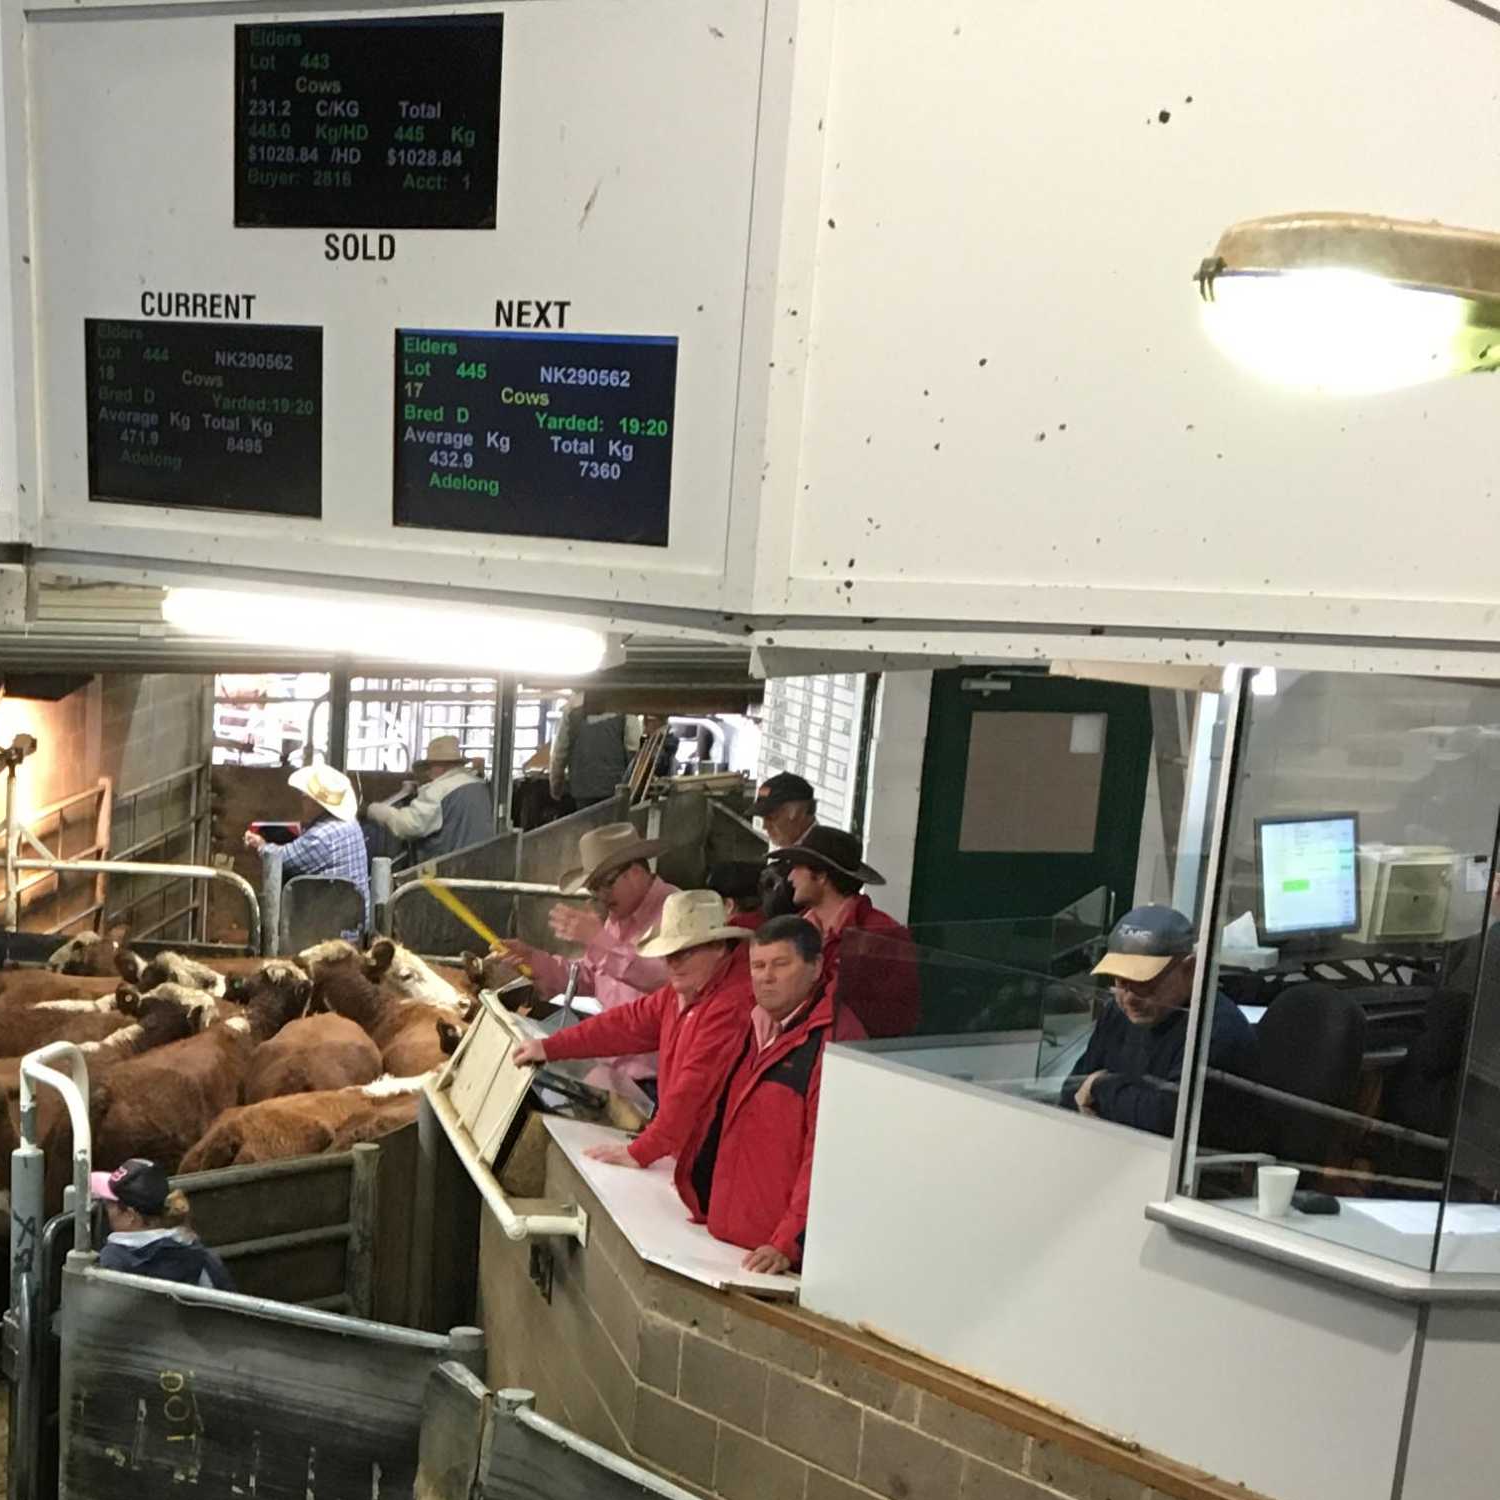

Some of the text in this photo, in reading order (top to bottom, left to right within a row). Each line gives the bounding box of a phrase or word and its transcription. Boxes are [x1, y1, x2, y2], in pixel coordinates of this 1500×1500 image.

[249, 53, 330, 70] Lot 443
[295, 77, 341, 94] Cows
[248, 100, 442, 119] 231.2 C/KG Total
[315, 124, 369, 143] Kg/HD
[394, 126, 425, 142] 445
[451, 127, 476, 147] Kg
[247, 145, 462, 167] $1028.84 /HD $1028.84
[324, 233, 396, 261] SOLD
[140, 291, 256, 320] CURRENT
[495, 299, 571, 329] NEXT
[403, 336, 458, 355] Elders
[181, 370, 225, 388] Cows
[404, 359, 487, 380] Lot 445
[540, 366, 631, 388] NK290562
[404, 382, 550, 407] 17 Cows
[99, 406, 274, 438] Average Kg Total Kg
[404, 405, 668, 437] Bred D Yarded: 19:20
[403, 426, 511, 453] Average Kg
[550, 435, 634, 461] Total Kg
[428, 451, 622, 480] 432.9 7360
[429, 471, 500, 497] Adelong
